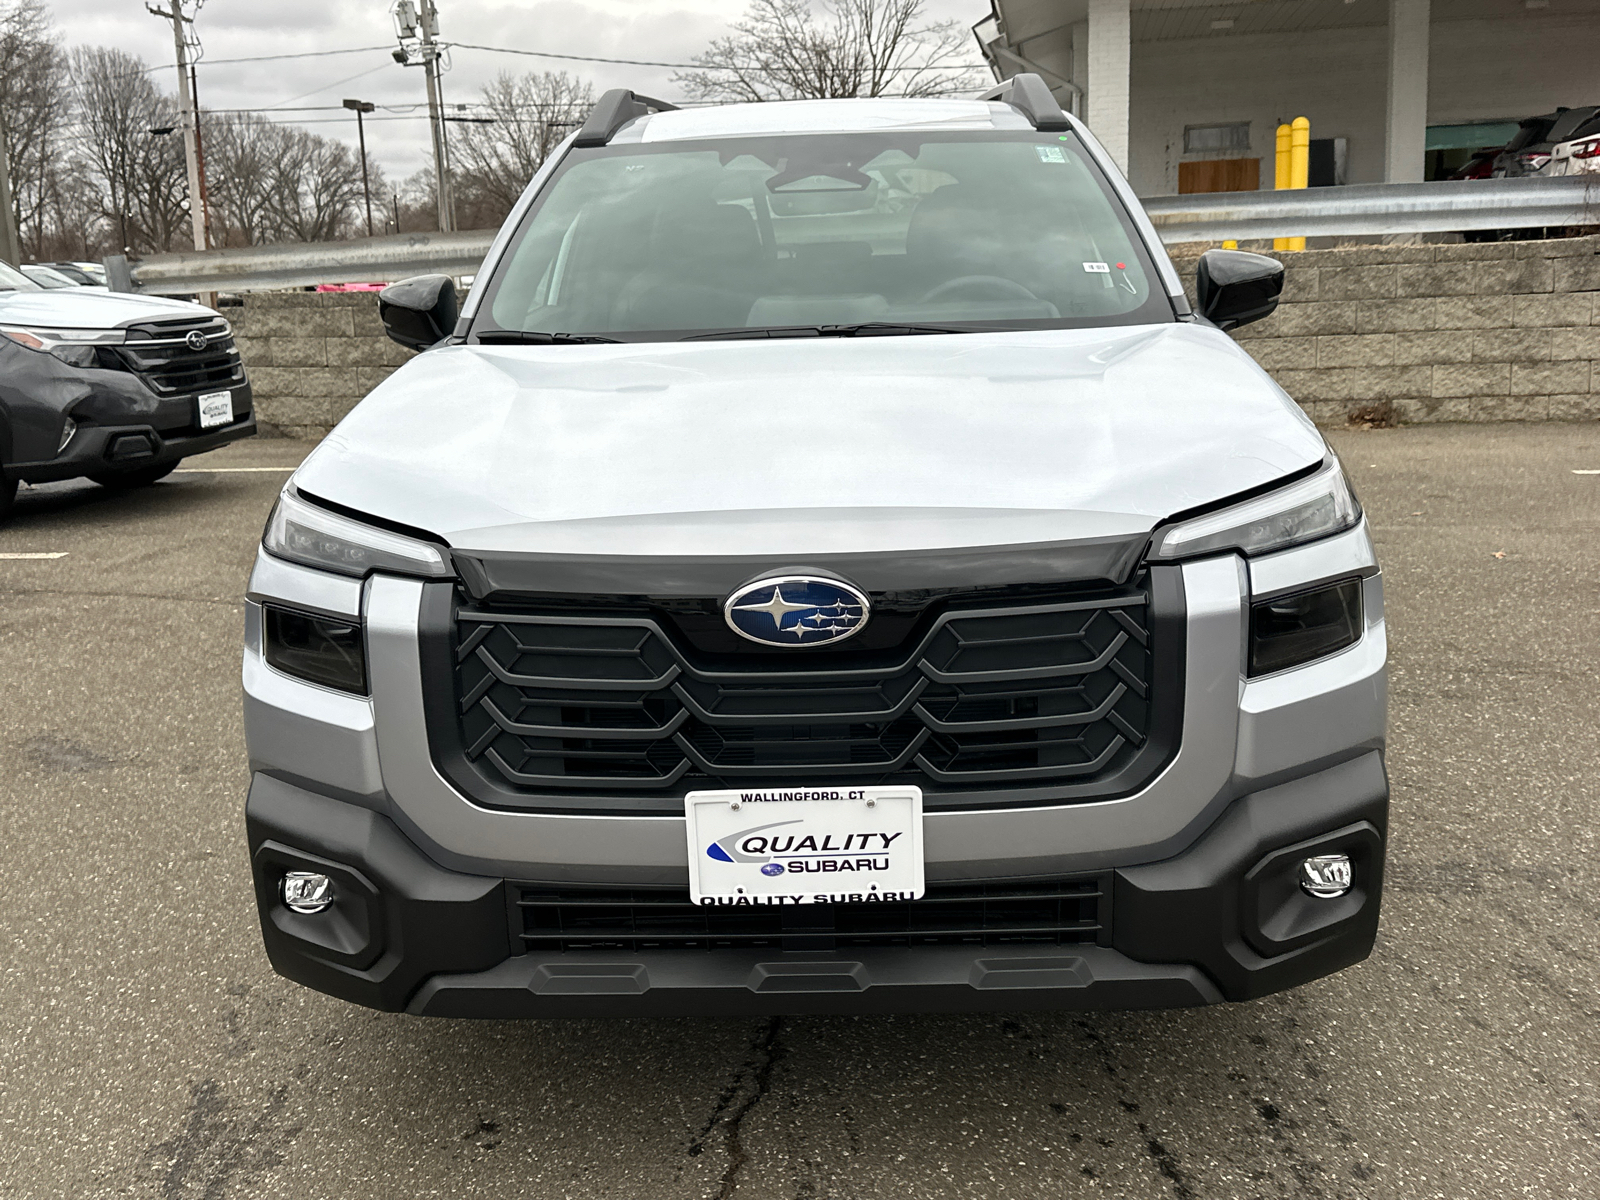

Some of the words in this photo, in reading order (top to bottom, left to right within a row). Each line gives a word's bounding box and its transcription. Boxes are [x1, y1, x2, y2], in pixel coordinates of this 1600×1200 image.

[740, 791, 843, 803] WALLINGFORD,
[848, 790, 865, 800] CT
[741, 832, 903, 854] QUALITY
[787, 858, 889, 873] SUBARU
[699, 895, 804, 906] QUALITY
[813, 891, 915, 904] SUBARU
